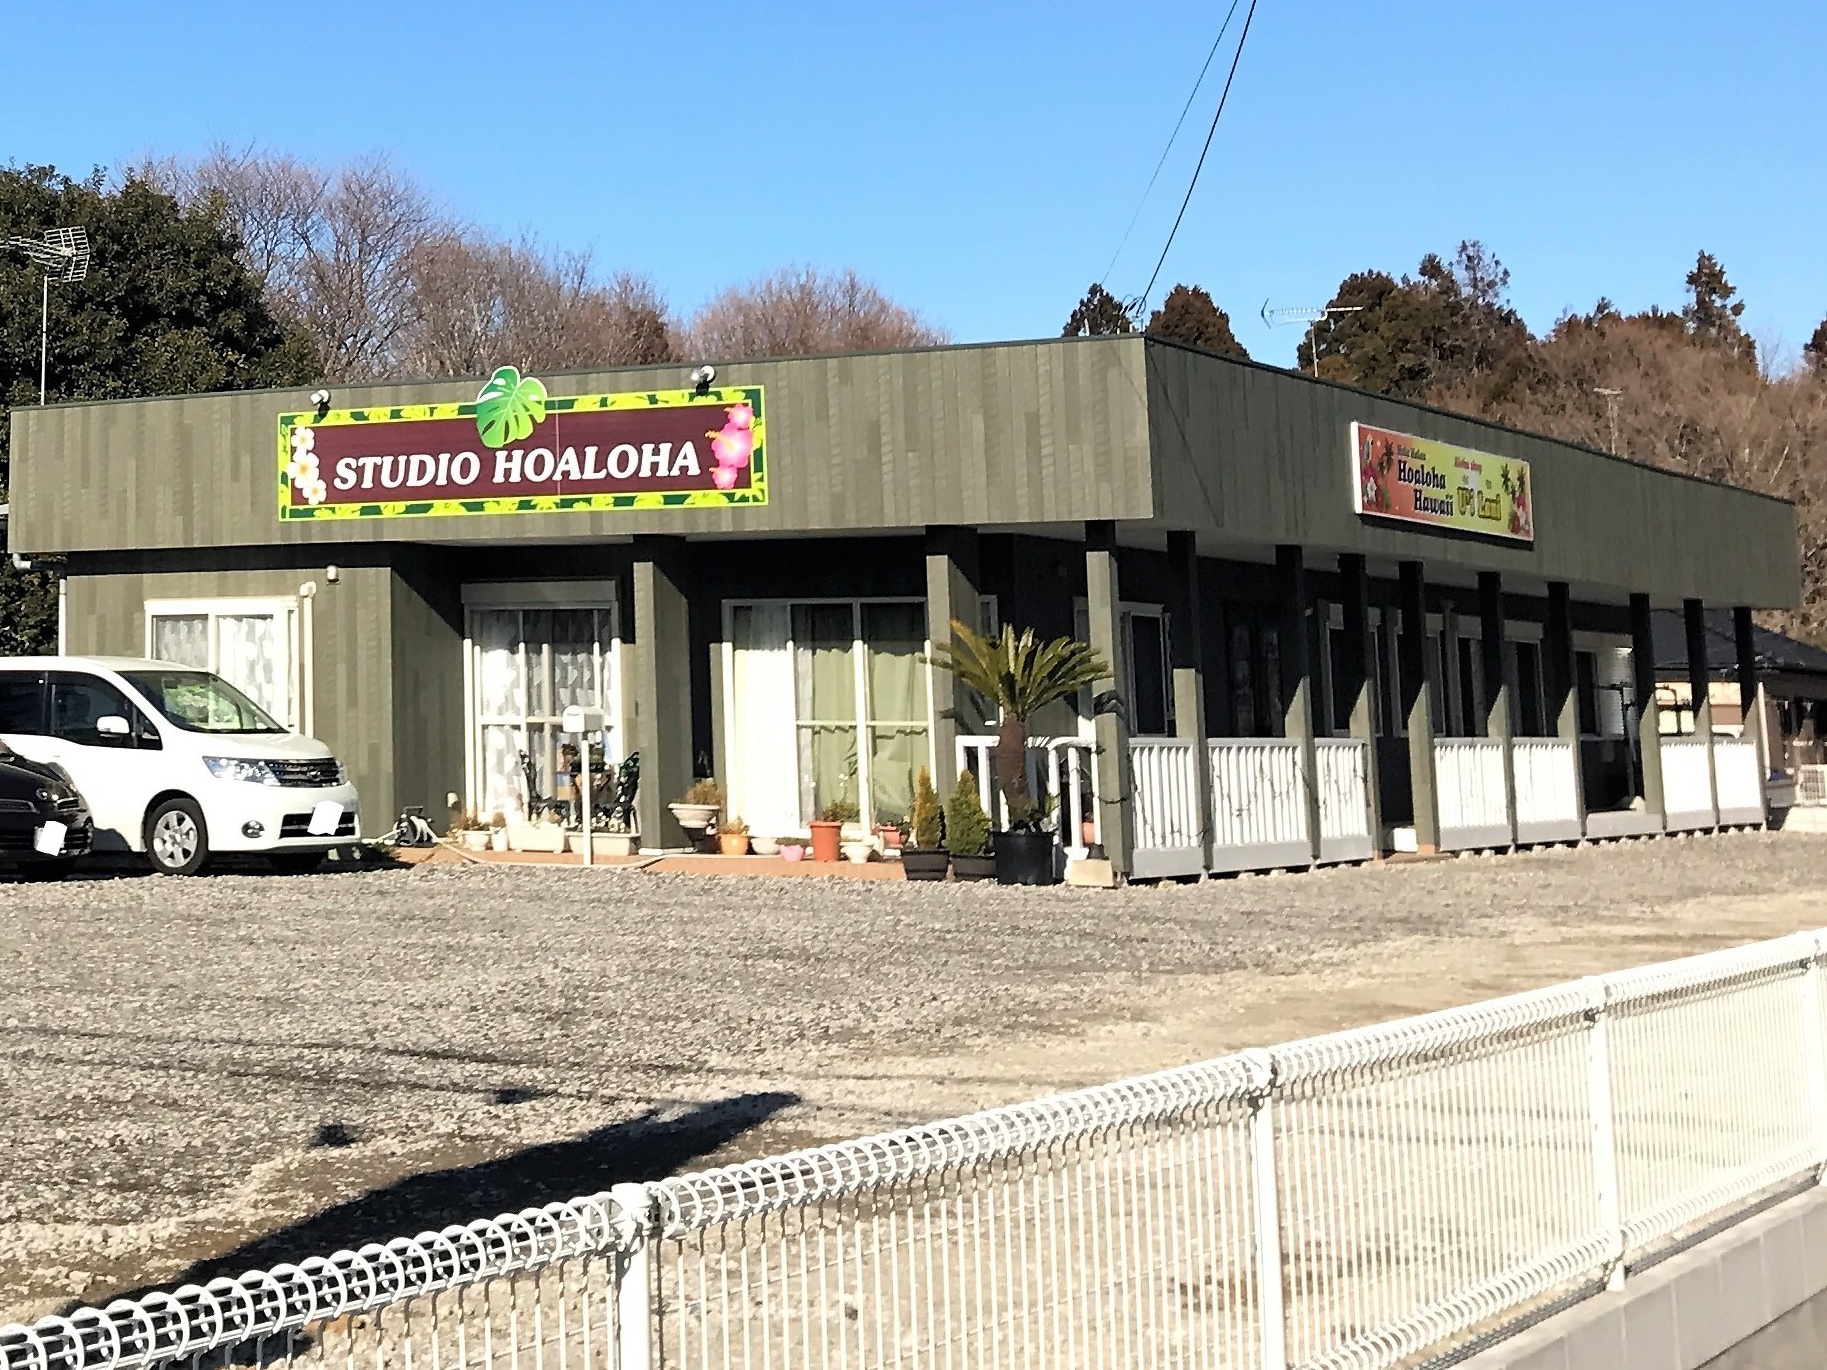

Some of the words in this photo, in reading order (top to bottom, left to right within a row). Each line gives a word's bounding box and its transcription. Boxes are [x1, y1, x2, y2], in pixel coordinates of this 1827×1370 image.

[332, 451, 482, 492] STUDIO
[491, 440, 702, 485] HOALOHA
[1397, 459, 1447, 490] Hoaloha
[1413, 488, 1454, 517] Hawaii
